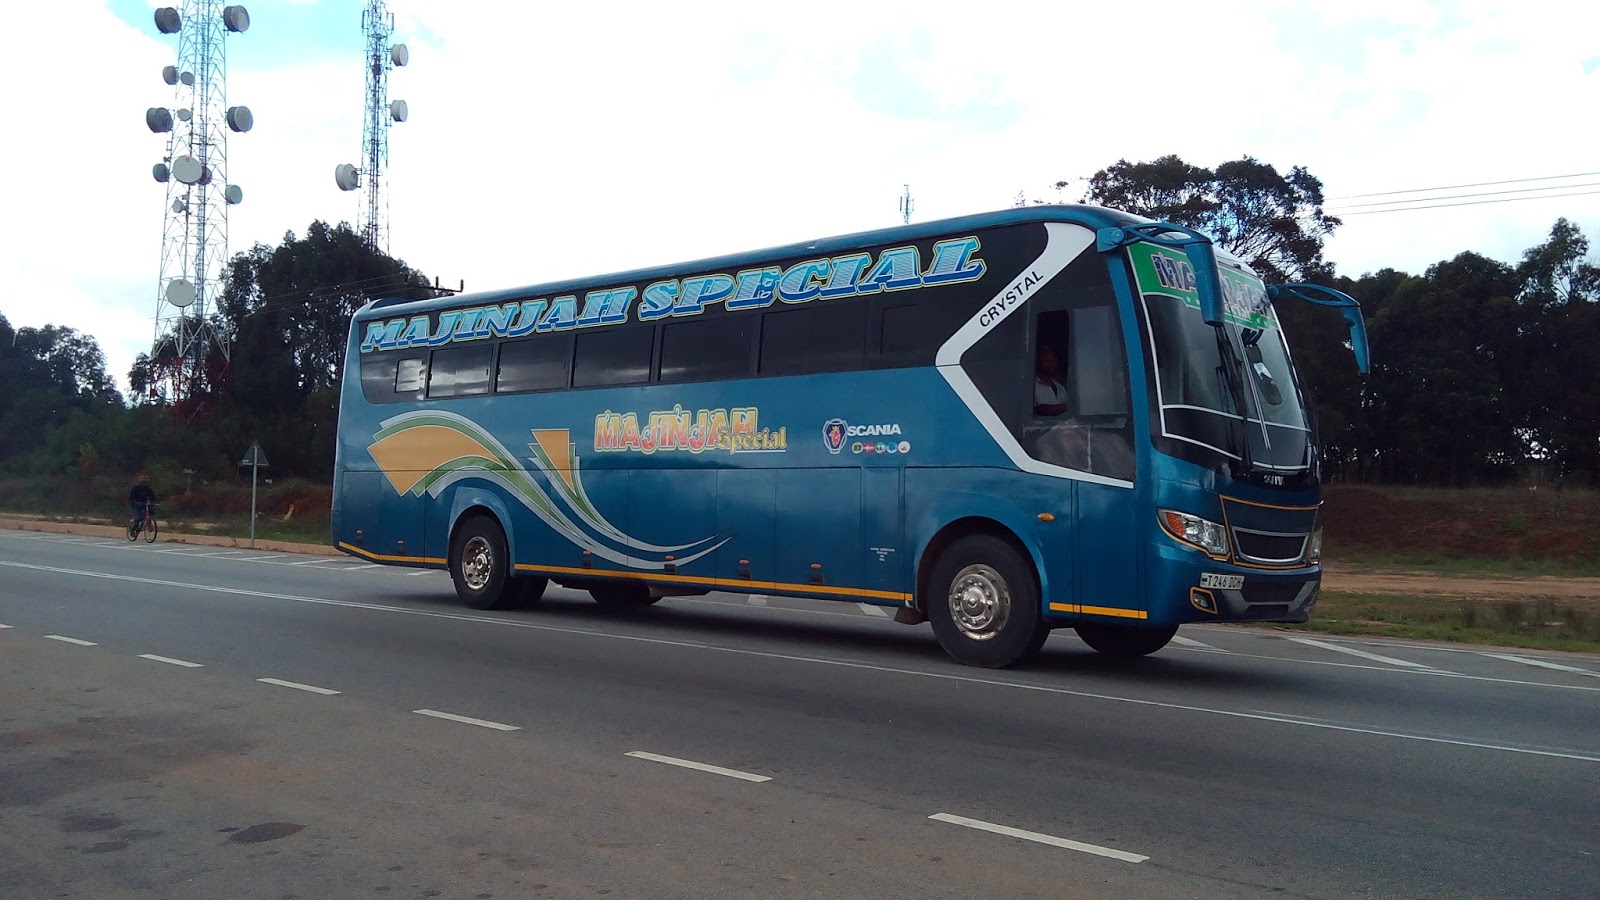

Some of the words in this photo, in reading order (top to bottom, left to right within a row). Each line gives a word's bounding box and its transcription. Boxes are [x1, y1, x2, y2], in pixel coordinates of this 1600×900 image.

[361, 286, 637, 352] MAJINJAH
[638, 235, 987, 323] SPECIAL
[979, 270, 1044, 327] CRYSTAL
[594, 403, 758, 454] MAJINJAH
[715, 426, 787, 455] Special
[847, 423, 902, 437] SCANIA
